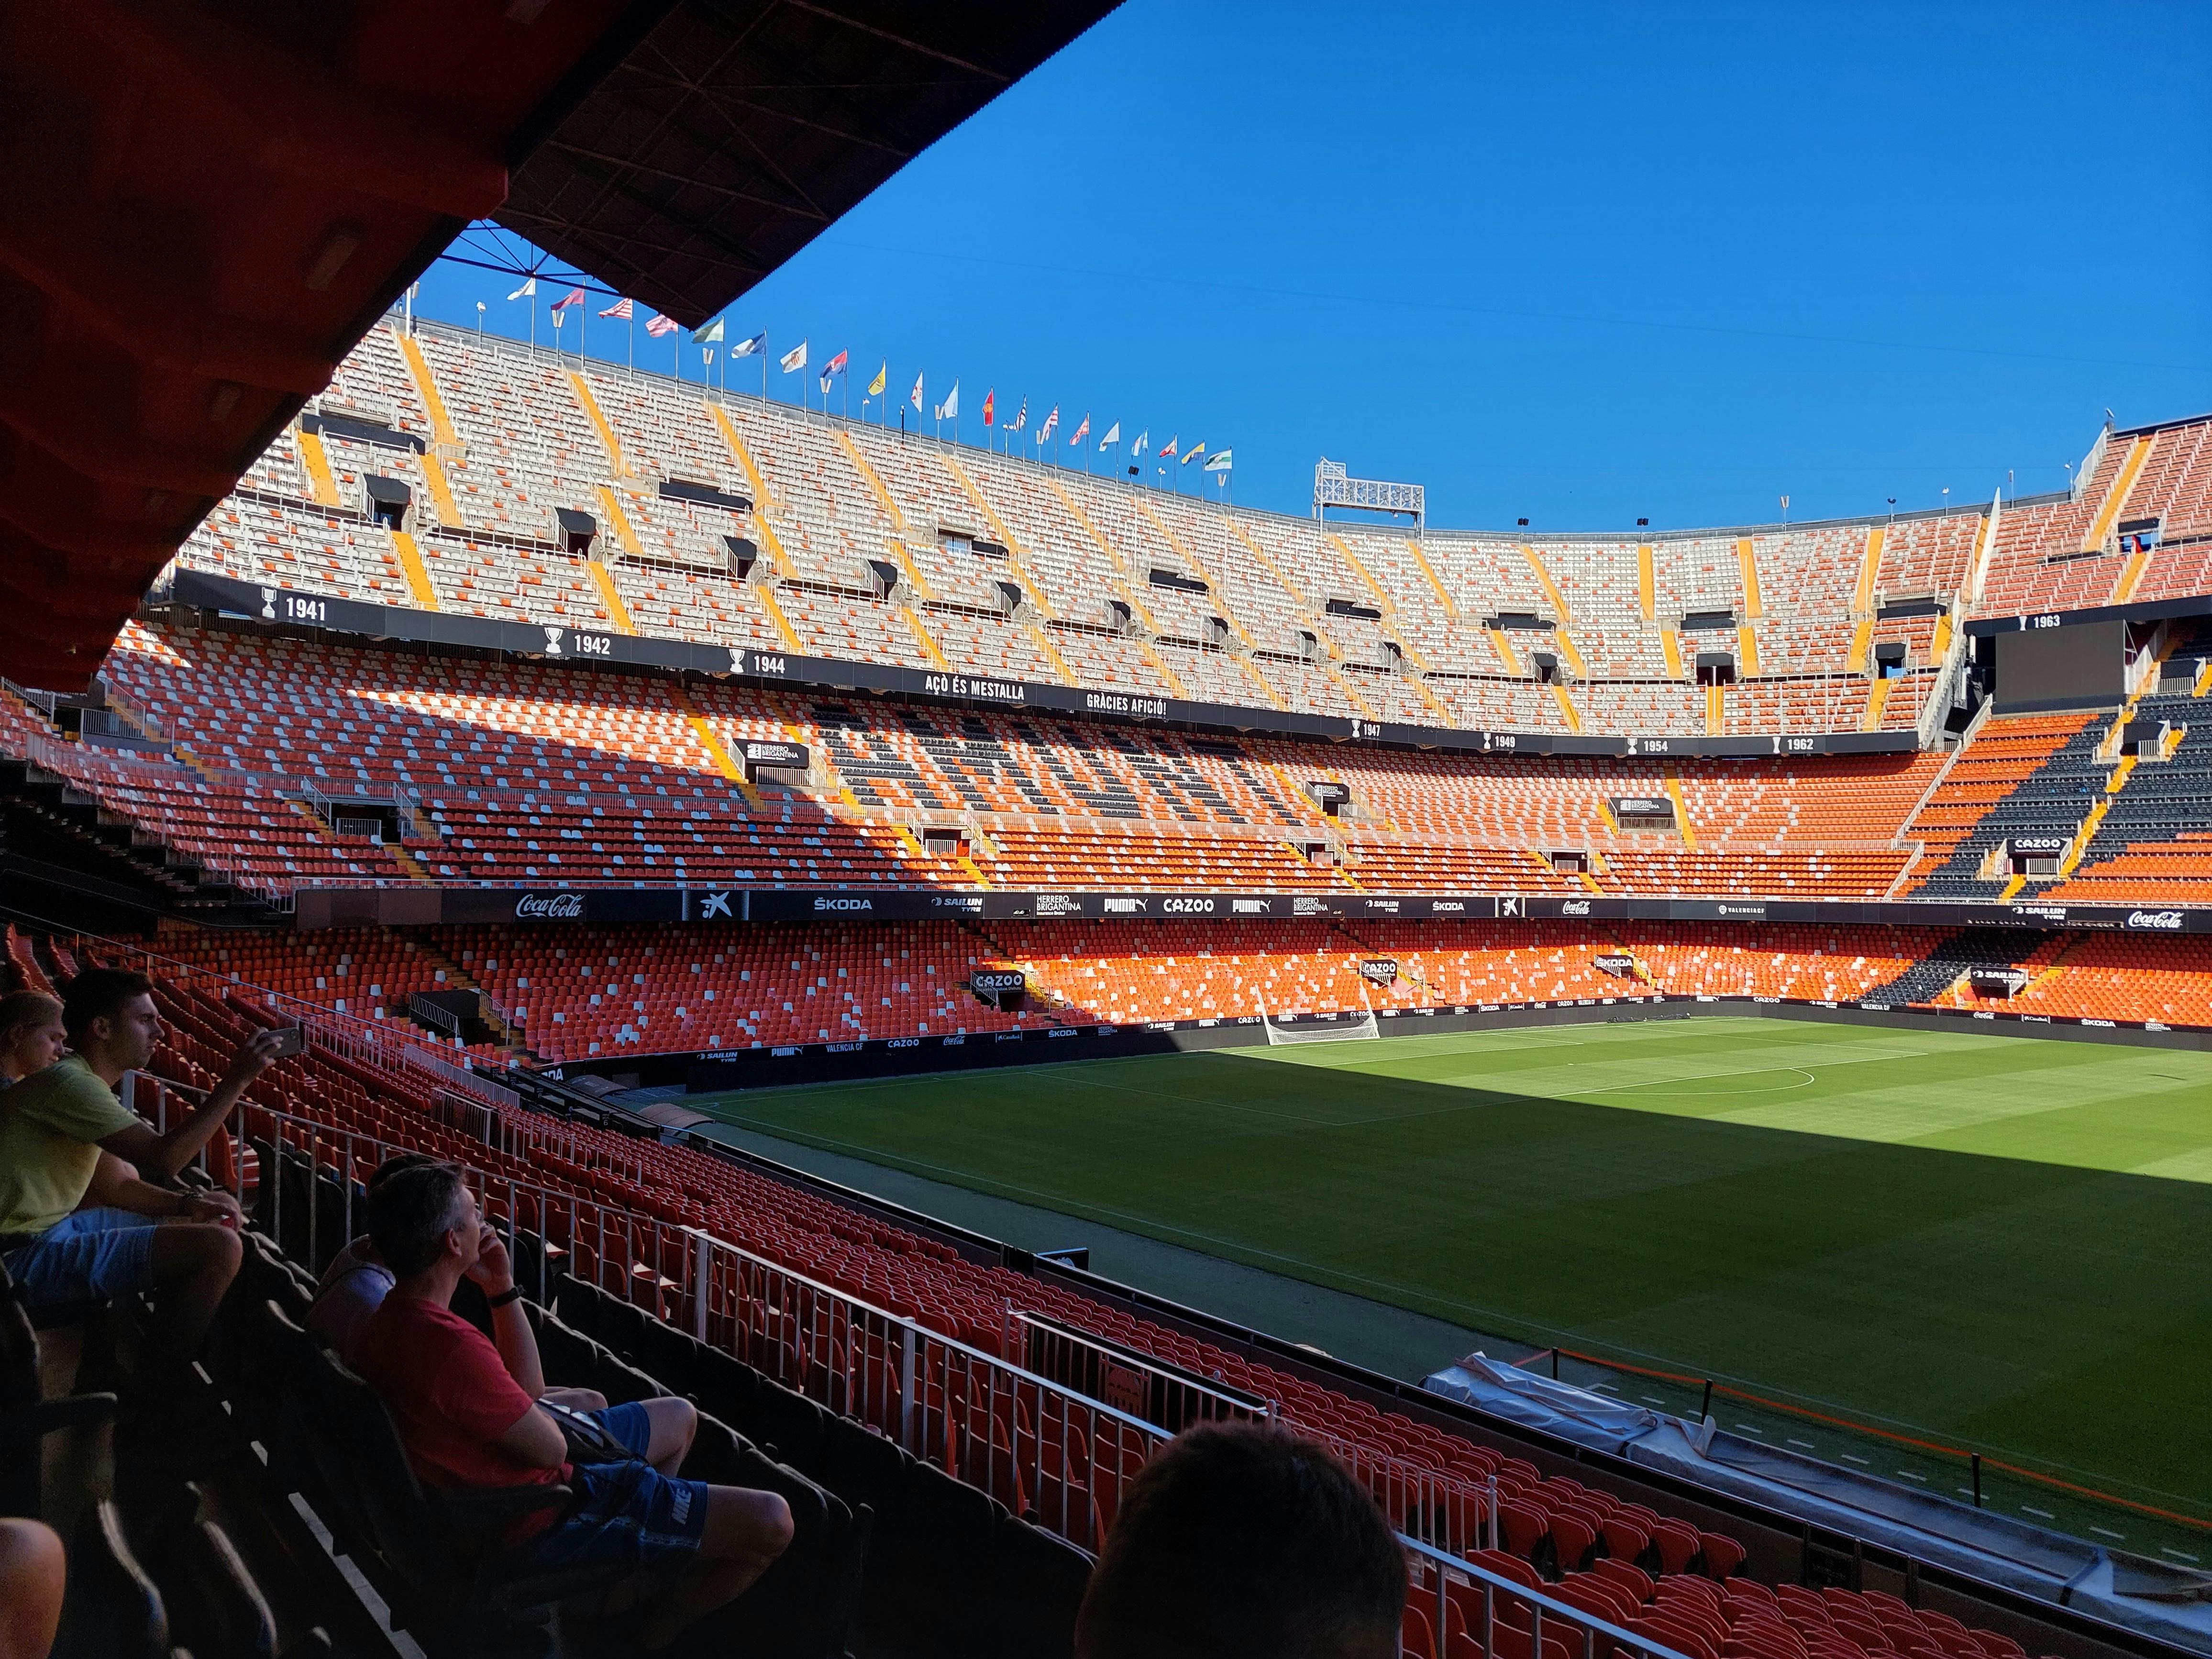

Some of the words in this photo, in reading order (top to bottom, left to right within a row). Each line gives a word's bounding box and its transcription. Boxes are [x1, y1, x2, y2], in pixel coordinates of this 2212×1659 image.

[287, 597, 325, 621] 1941
[2034, 615, 2060, 629] 1963
[575, 635, 610, 655] 1942
[754, 655, 785, 674] 1944
[925, 675, 948, 695] AÇÒ
[952, 676, 967, 694] ÉS
[971, 682, 1024, 700] MESTALLA
[1086, 692, 1128, 711] GRÀCIES
[1131, 698, 1167, 716] AFICIÓ!
[1363, 723, 1381, 737] 1947
[762, 744, 789, 752] HERRERO
[1495, 735, 1515, 748] 1949
[1644, 740, 1669, 752] 1954
[1787, 739, 1814, 751] 1962
[762, 751, 799, 759] BRIGANTINA
[2015, 839, 2060, 848] CAZOO
[814, 897, 872, 910] ŠKODA
[944, 898, 982, 906] SAILUN
[1037, 895, 1070, 903] HERRERO
[1104, 898, 1137, 912] PUMA
[1432, 900, 1465, 911] ŠKODA
[516, 894, 586, 918] Coca-Cola
[1037, 902, 1081, 911] BRIGANTINA
[1163, 899, 1214, 913] CAZOO
[1233, 899, 1261, 913] PUMA
[1562, 900, 1591, 914] Coca-Cola
[2128, 910, 2184, 929] Coca-Cola
[976, 974, 1022, 987] CAZOO
[1985, 971, 2024, 979] SAILUN
[2081, 1018, 2116, 1028] ŠKODA
[1048, 1029, 1078, 1038] ŠKODA
[826, 1044, 854, 1052] VALENCIA
[855, 1043, 863, 1051] CF
[888, 1039, 919, 1048] CAZOO
[771, 1047, 796, 1056] PUMA
[671, 1488, 692, 1525] NIKE
